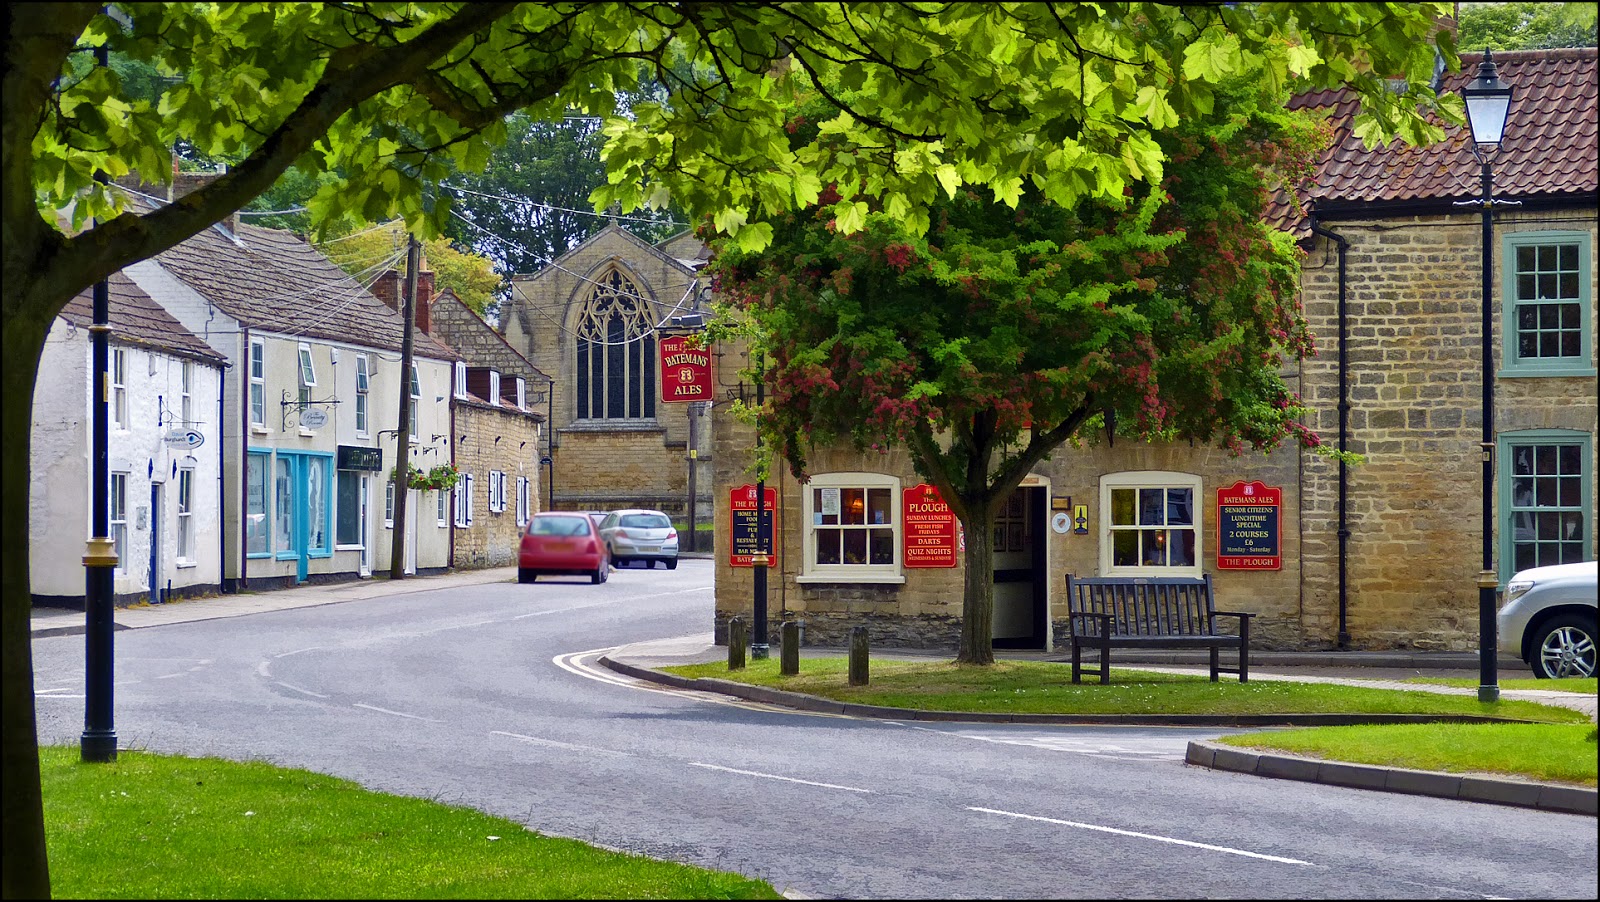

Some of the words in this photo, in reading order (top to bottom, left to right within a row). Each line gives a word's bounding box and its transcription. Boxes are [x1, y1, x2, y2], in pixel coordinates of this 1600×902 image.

[664, 354, 708, 367] BATEMANS
[674, 385, 702, 395] ALES
[909, 504, 948, 512] PLOUGH
